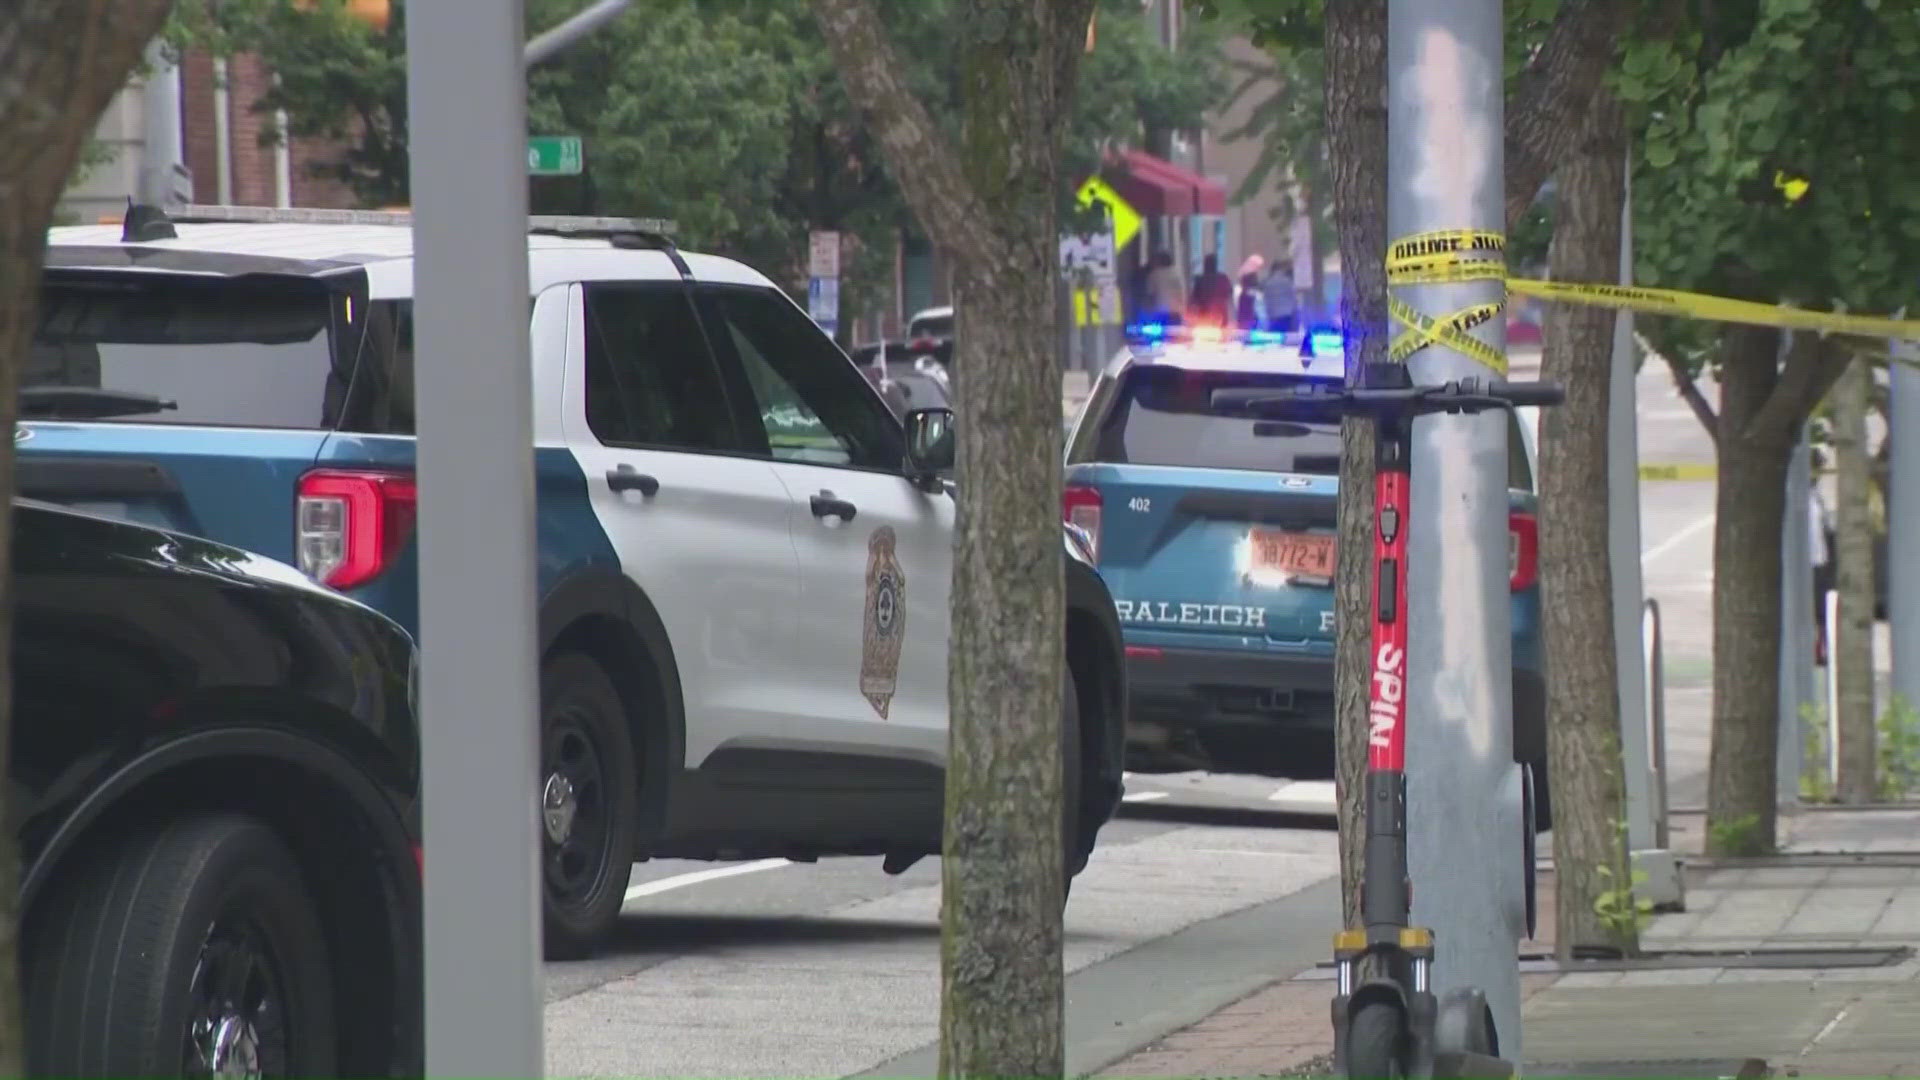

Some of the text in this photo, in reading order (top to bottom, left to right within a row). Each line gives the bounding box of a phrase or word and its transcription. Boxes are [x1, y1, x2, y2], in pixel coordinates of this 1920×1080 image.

[1128, 496, 1151, 513] 402
[1114, 599, 1266, 628] RALEIGH
[1370, 642, 1403, 748] SPIN
